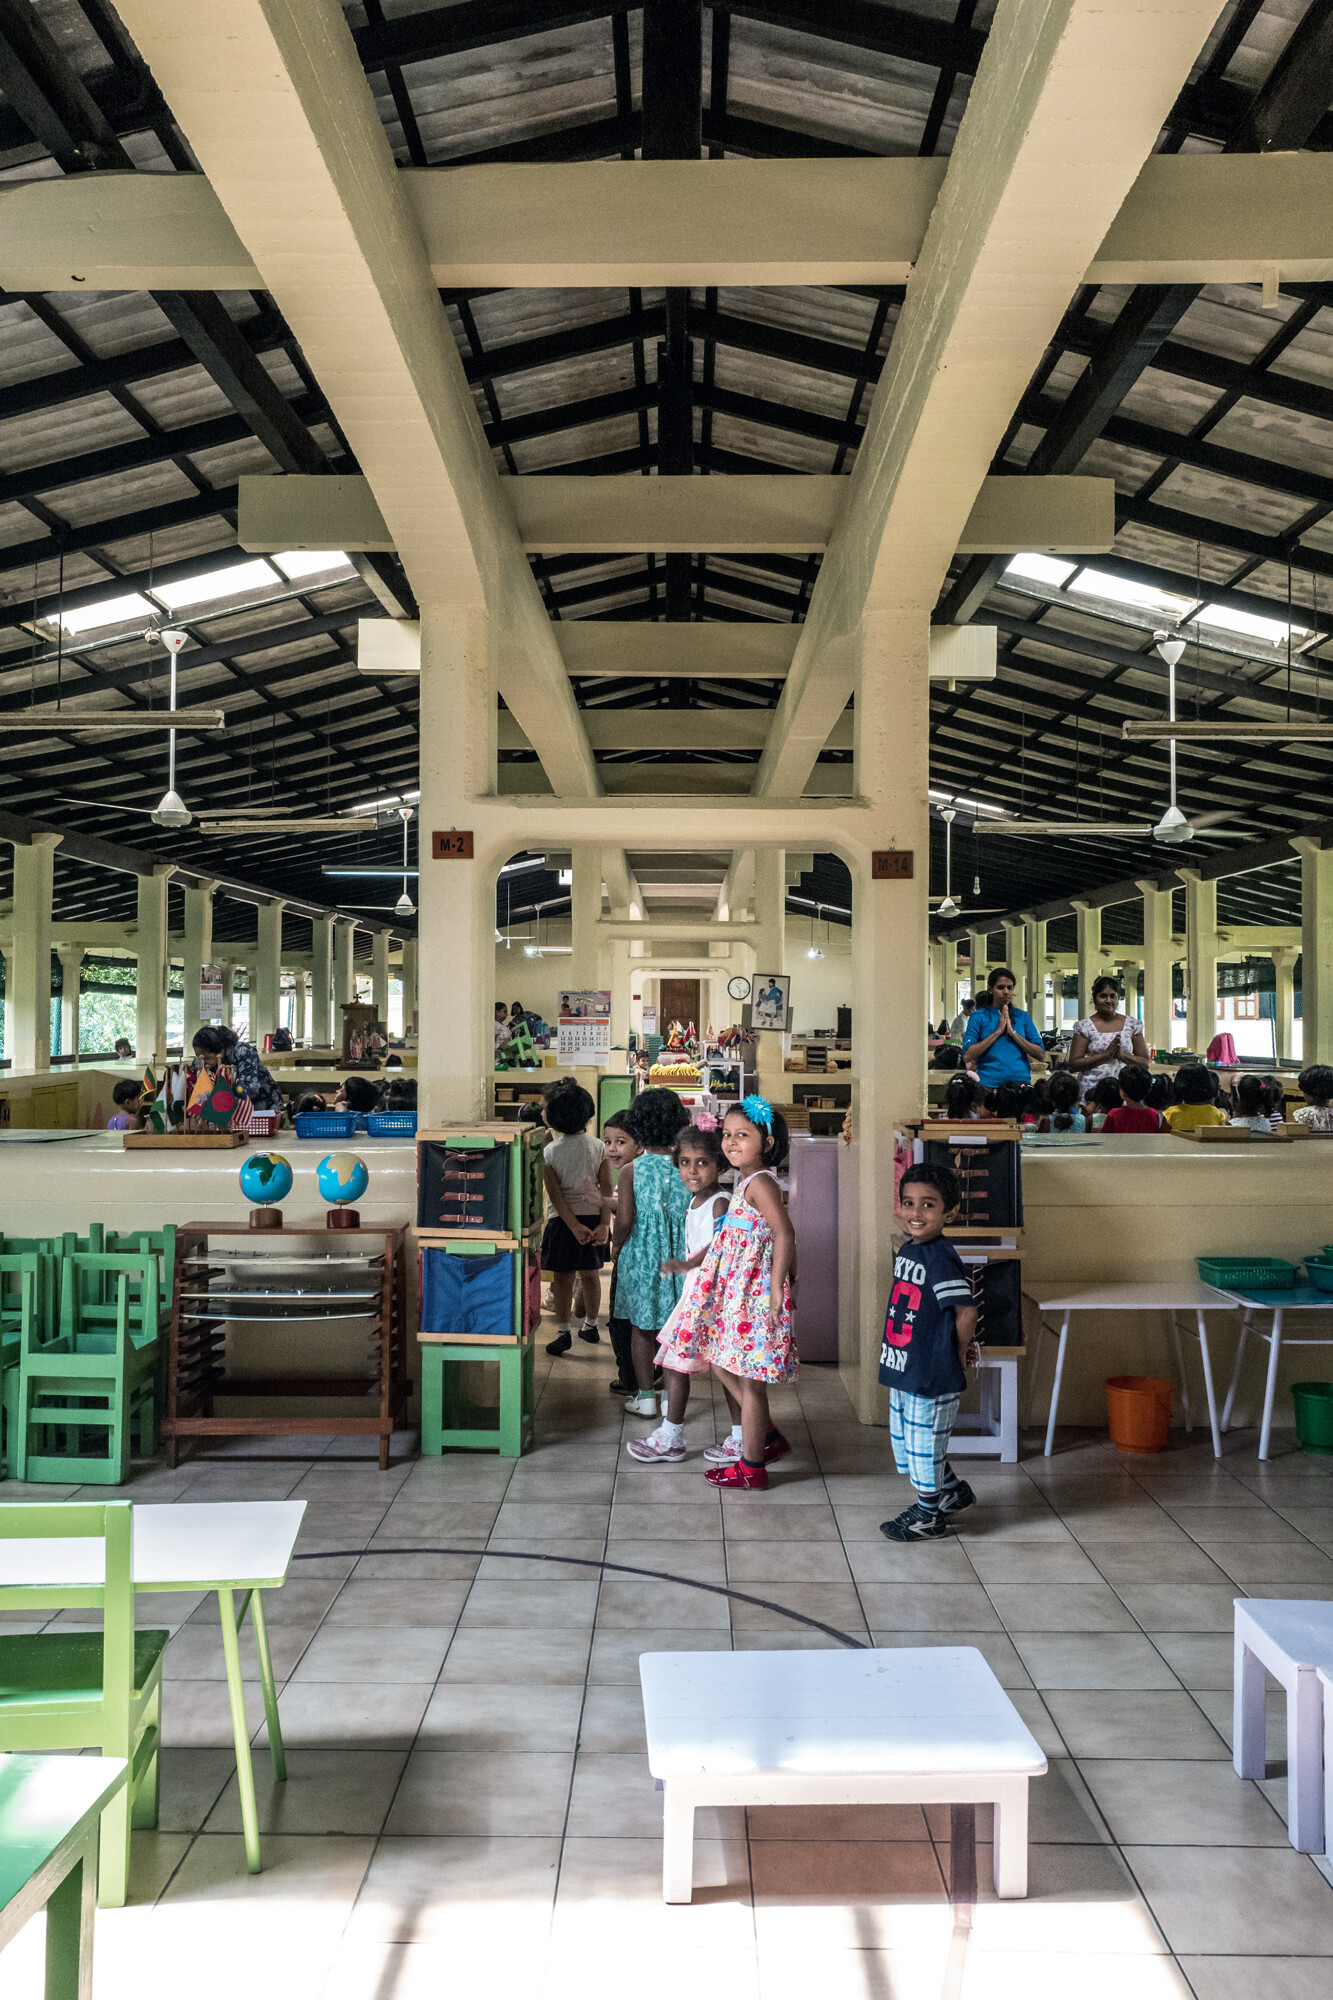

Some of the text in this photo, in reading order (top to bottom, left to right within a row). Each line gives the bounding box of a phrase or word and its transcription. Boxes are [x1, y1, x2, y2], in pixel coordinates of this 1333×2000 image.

[440, 837, 464, 852] M-2
[894, 1256, 926, 1286] KYO
[880, 1342, 908, 1372] PAN
